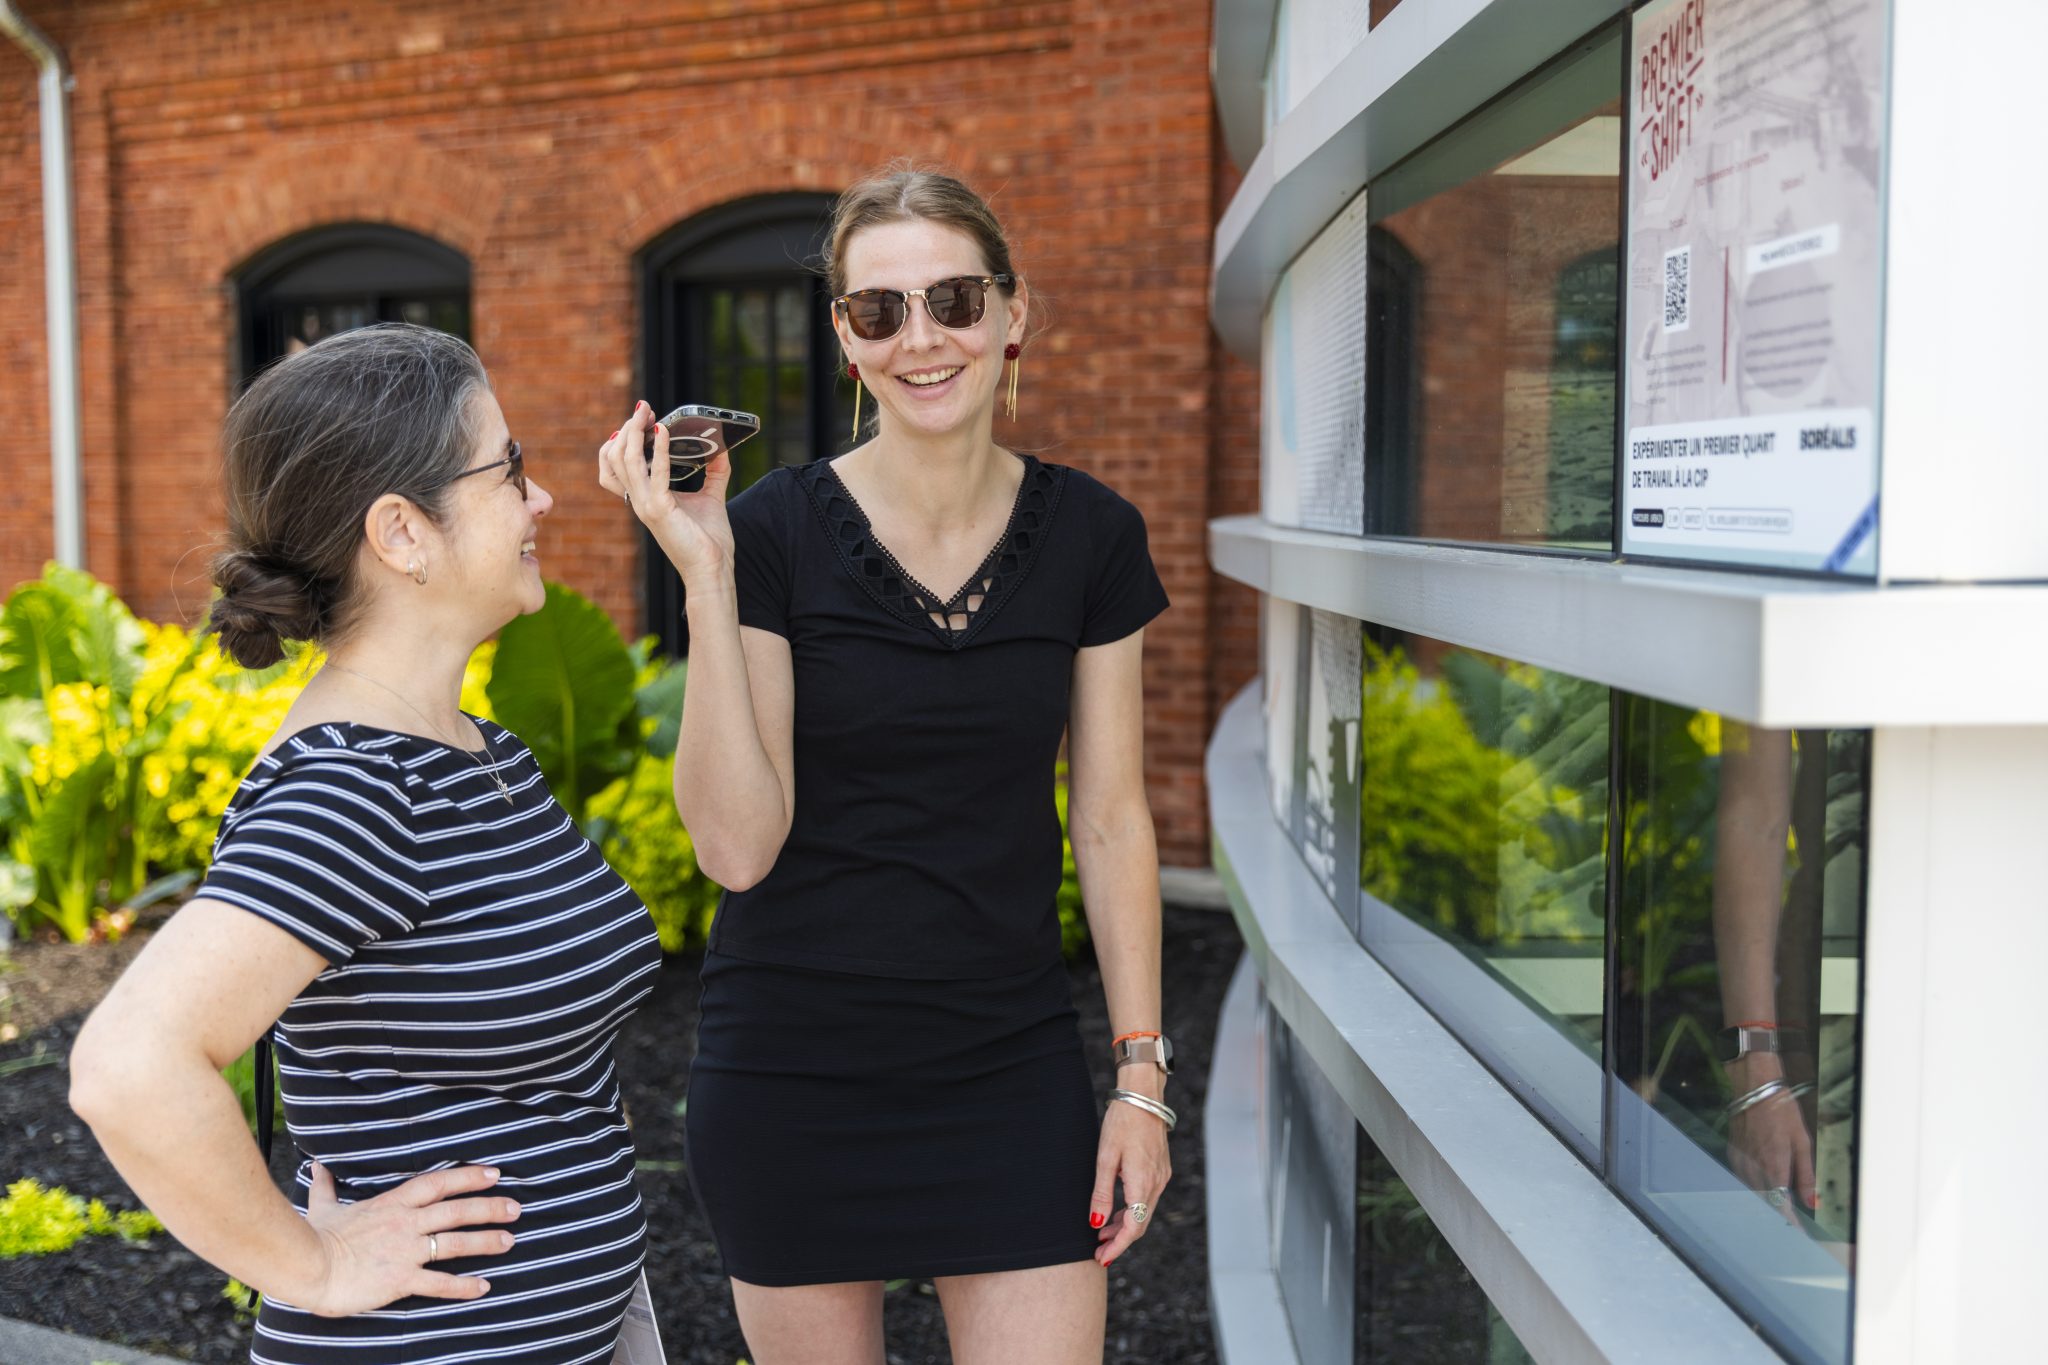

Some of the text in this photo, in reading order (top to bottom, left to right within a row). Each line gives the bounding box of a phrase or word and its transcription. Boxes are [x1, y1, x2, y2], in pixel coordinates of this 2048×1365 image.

[1641, 0, 1704, 113] PREMIER
[1632, 432, 1775, 459] EXPÉRIMENTER UN PREMIER QUART
[1800, 424, 1856, 450] BORÉALIS
[1632, 471, 1641, 488] DE
[1643, 469, 1672, 488] TRAVAIL
[1674, 466, 1680, 488] À
[1682, 469, 1692, 488] LA
